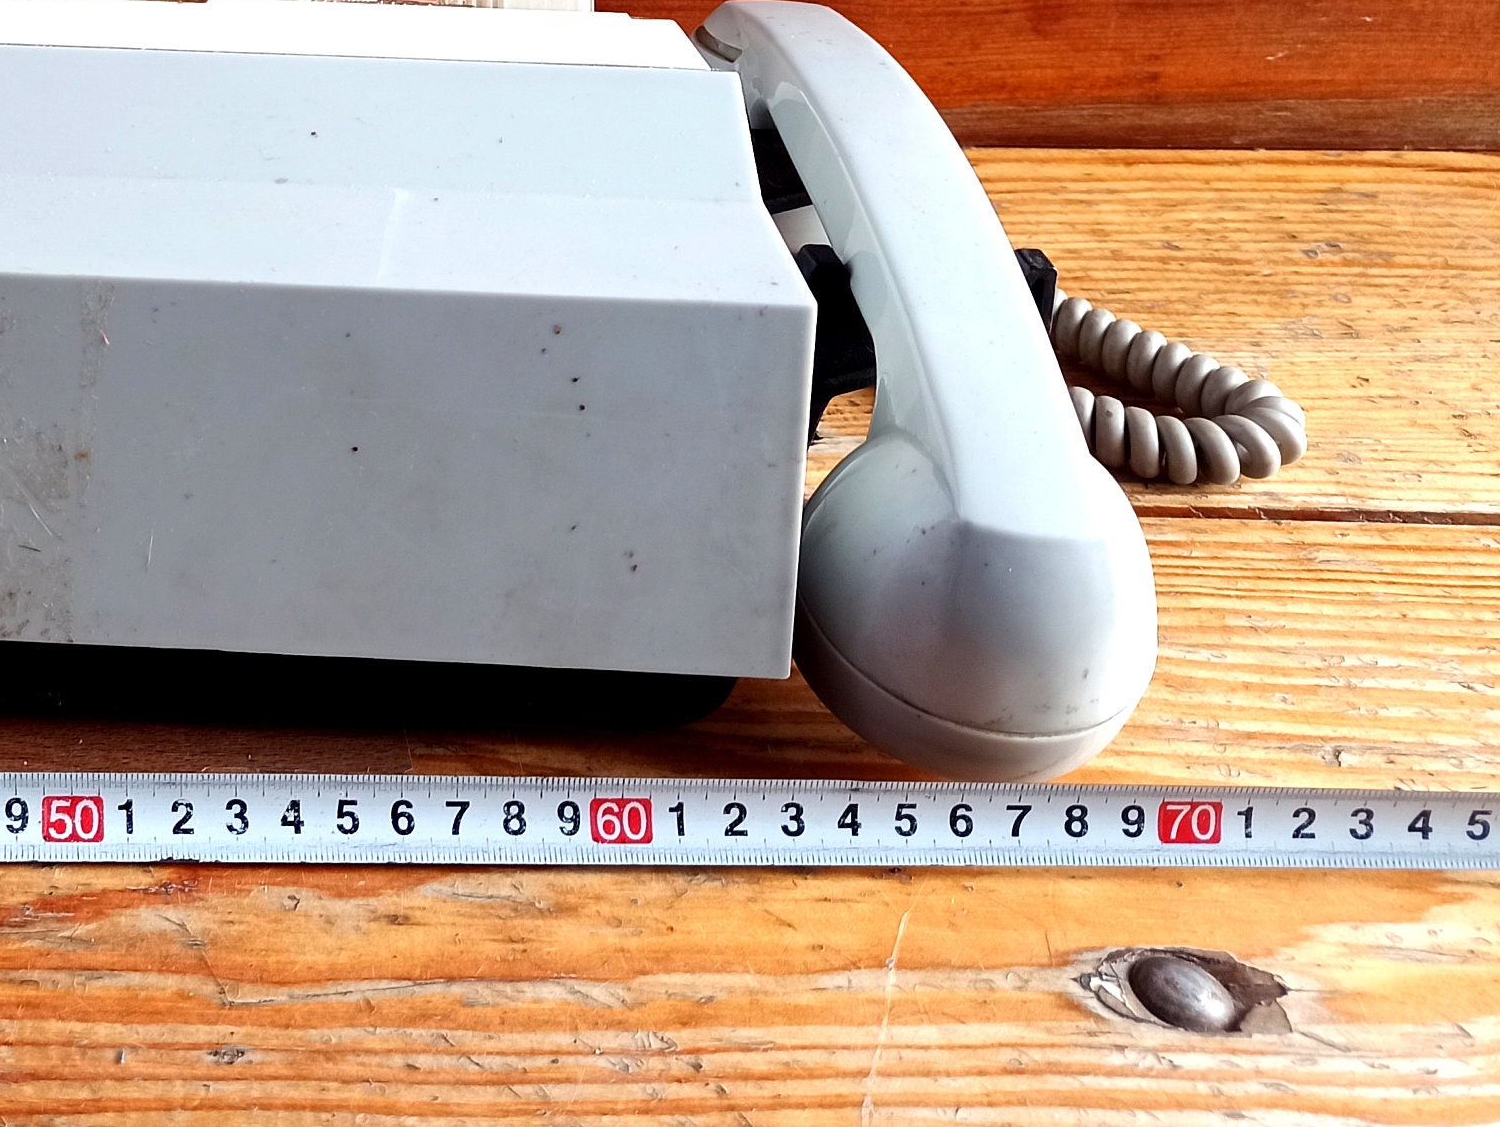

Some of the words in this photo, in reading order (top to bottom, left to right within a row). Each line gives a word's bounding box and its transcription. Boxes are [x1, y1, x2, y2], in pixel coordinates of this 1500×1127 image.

[5, 798, 28, 833] 9
[49, 799, 98, 839] 50
[118, 800, 133, 834] 1
[172, 801, 194, 834] 2
[226, 799, 248, 834] 3
[281, 800, 304, 834] 4
[337, 800, 359, 834] 5
[391, 800, 414, 835] 6
[446, 801, 469, 835] 7
[503, 801, 526, 835] 8
[558, 801, 580, 835] 9
[597, 802, 646, 840] 60
[669, 802, 684, 836] 1
[724, 803, 748, 836] 2
[781, 803, 804, 836] 3
[838, 804, 861, 836] 4
[895, 804, 917, 836] 5
[950, 804, 973, 837] 6
[1007, 805, 1032, 836] 7
[1065, 805, 1088, 837] 8
[1122, 805, 1144, 837] 9
[1167, 805, 1215, 840] 70
[1238, 807, 1253, 838] 1
[1293, 808, 1315, 838] 2
[1350, 809, 1373, 839] 3
[1408, 810, 1432, 839] 4
[1467, 811, 1491, 840] 5
